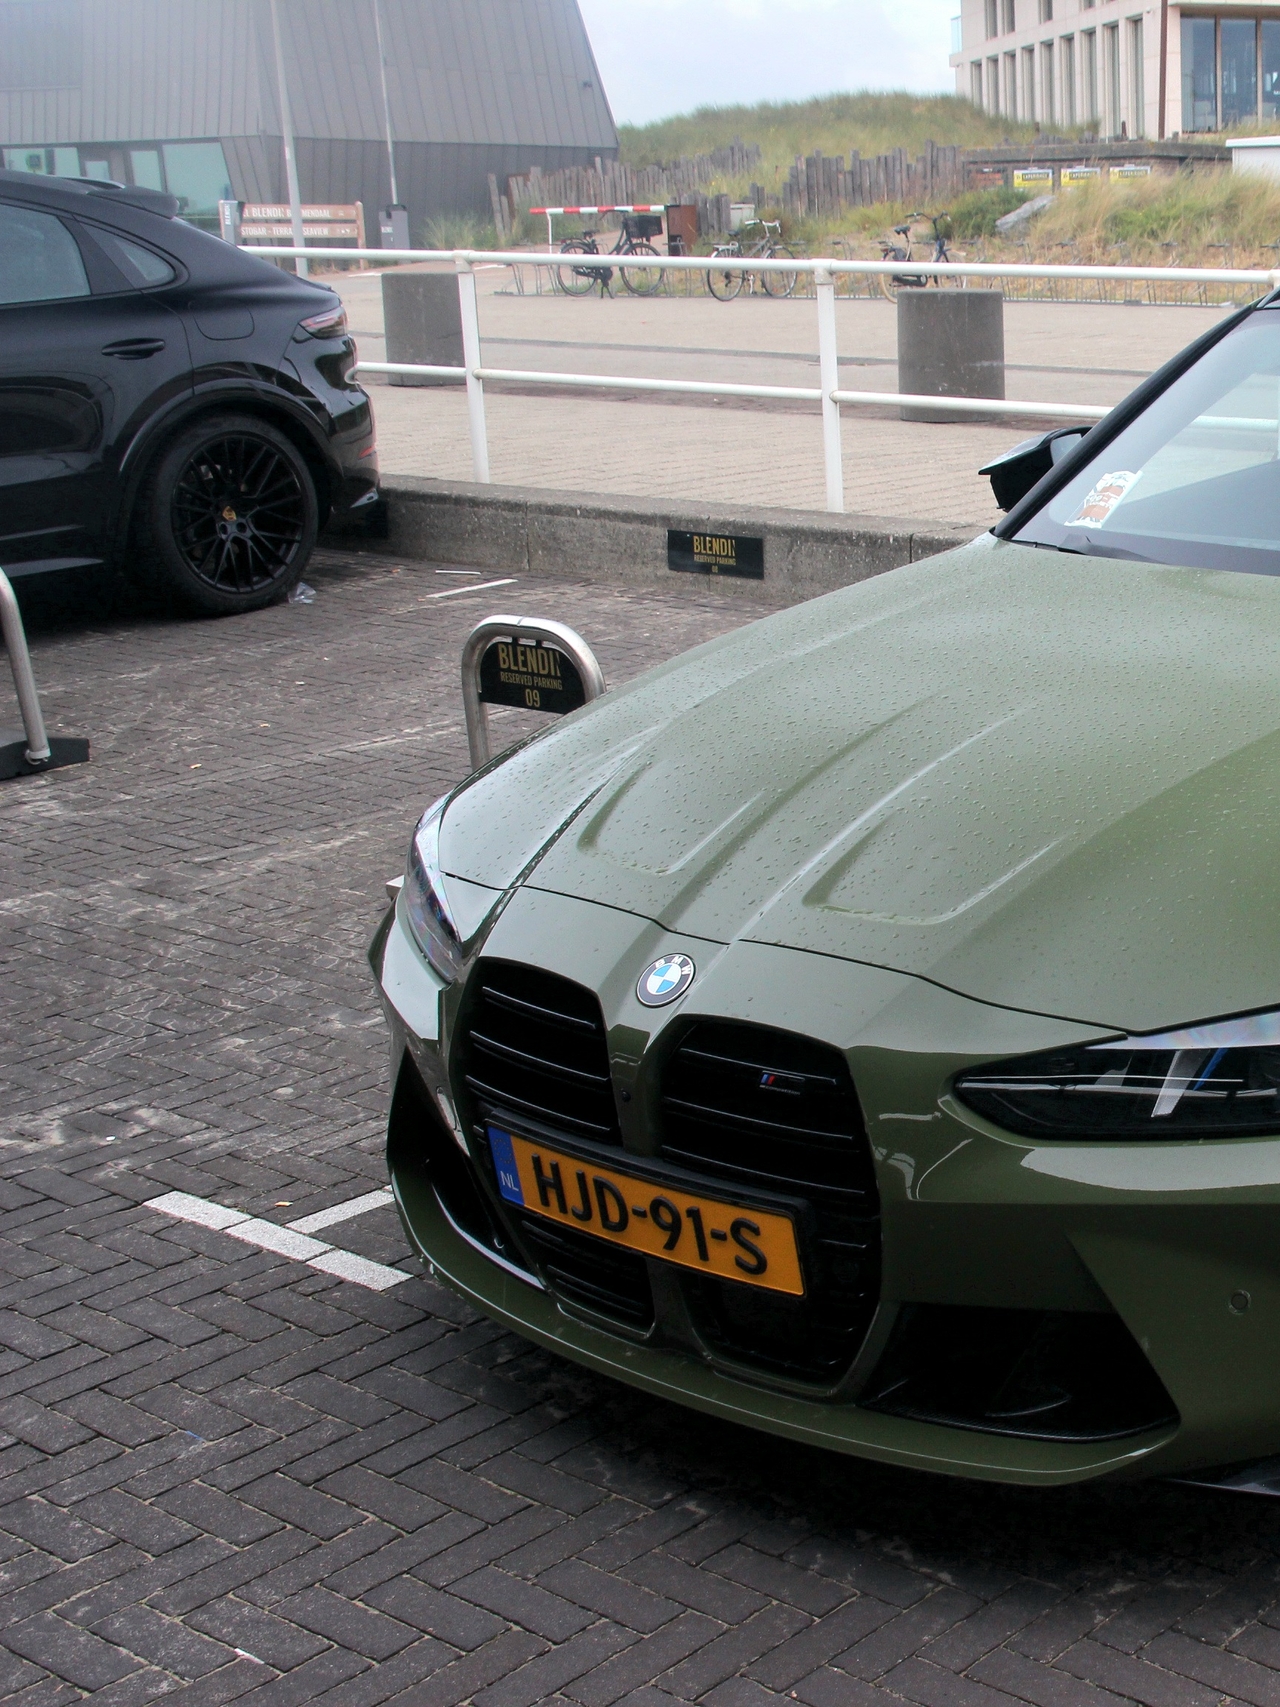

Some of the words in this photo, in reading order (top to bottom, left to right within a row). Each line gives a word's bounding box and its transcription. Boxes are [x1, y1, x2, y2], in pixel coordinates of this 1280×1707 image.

[500, 671, 533, 686] RESERVED
[533, 676, 563, 690] PARKING
[525, 688, 541, 708] 09
[655, 955, 691, 975] BMW
[500, 1170, 519, 1192] NL
[531, 1153, 768, 1276] HJD-91-S
